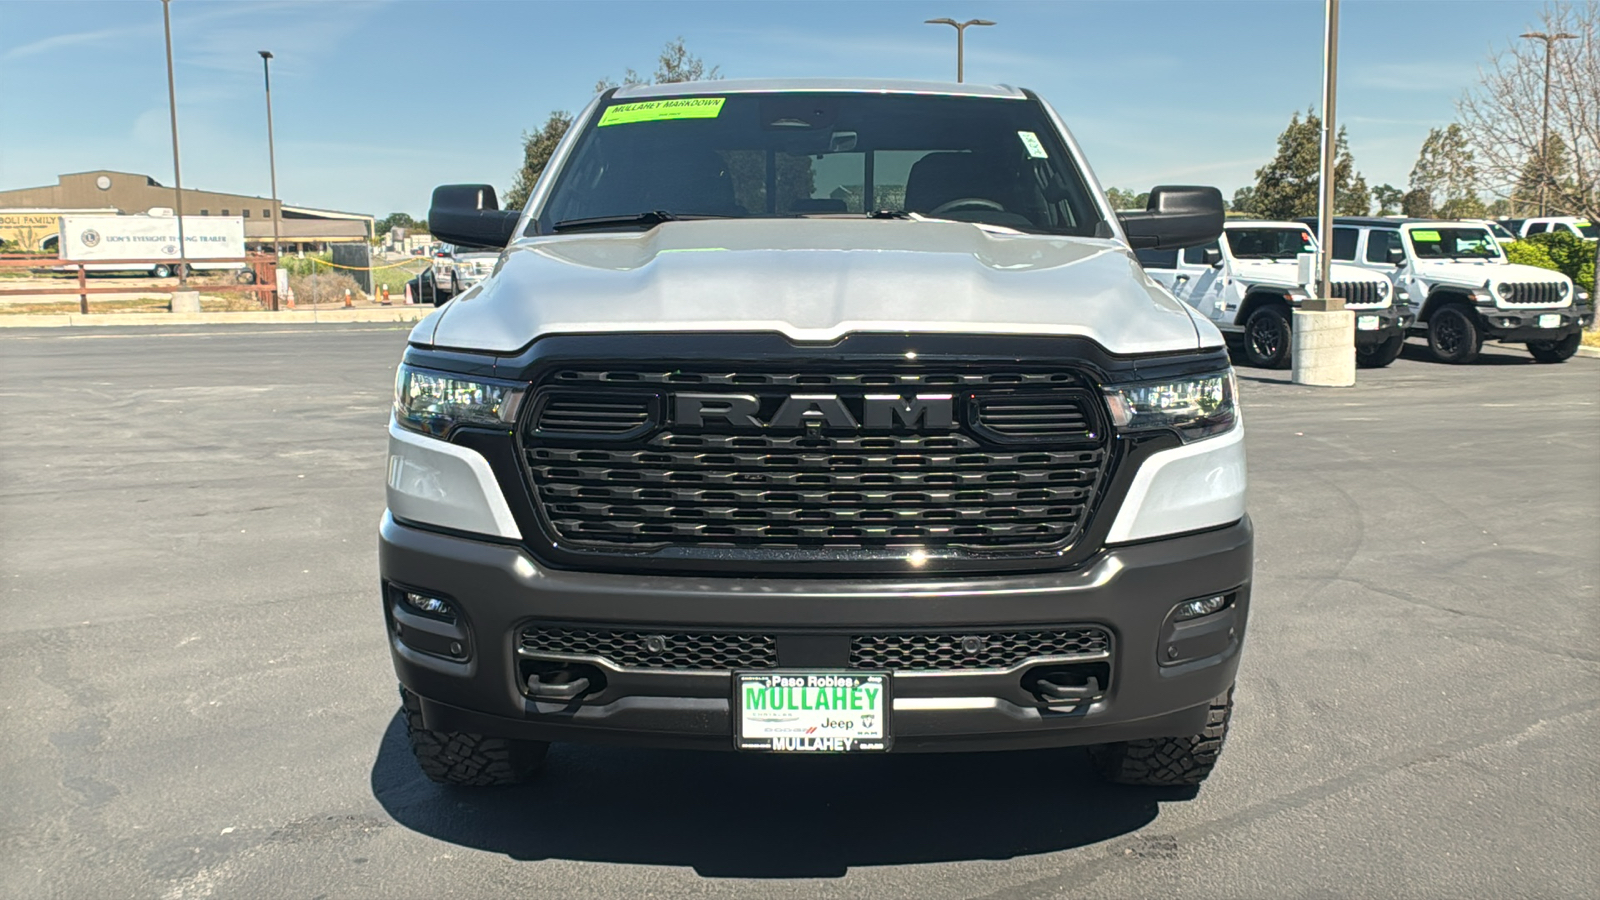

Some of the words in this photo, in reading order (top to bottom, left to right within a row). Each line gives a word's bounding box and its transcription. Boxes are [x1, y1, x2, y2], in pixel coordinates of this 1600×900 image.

[663, 99, 720, 108] MARKDOWN
[23, 216, 56, 224] FAMILY
[674, 393, 953, 428] RAM
[771, 675, 805, 688] Paso
[807, 675, 853, 688] Robles
[746, 687, 879, 711] MULLAHEY
[821, 717, 854, 731] Jeep
[773, 737, 853, 751] MULLAHEY
